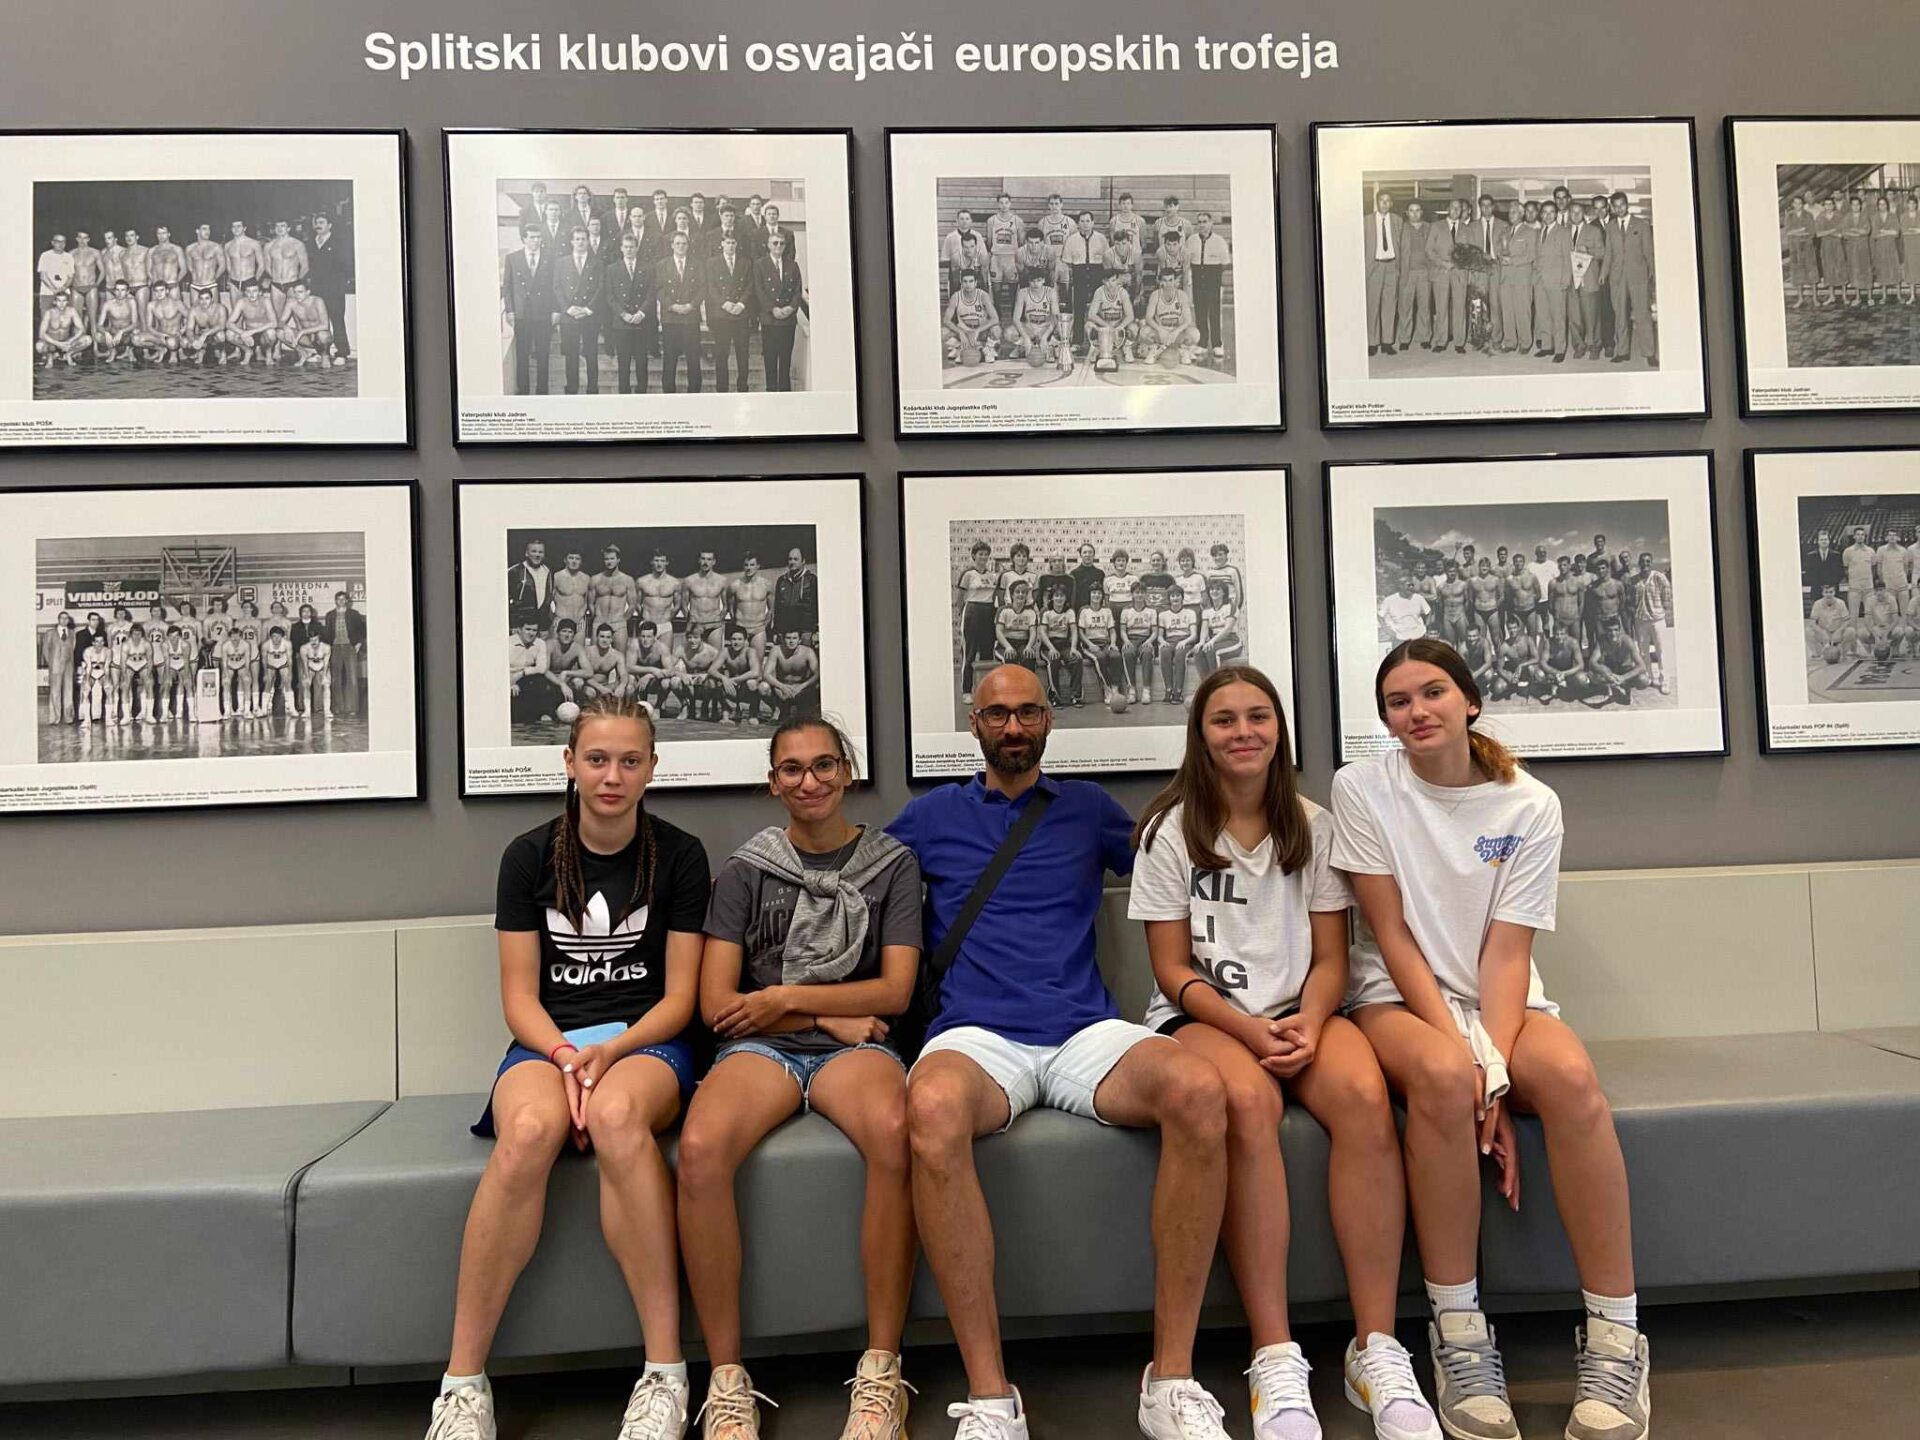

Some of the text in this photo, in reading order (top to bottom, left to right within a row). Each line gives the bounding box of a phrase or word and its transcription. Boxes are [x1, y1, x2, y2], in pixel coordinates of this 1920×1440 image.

[365, 32, 1338, 81] Splitski klubovi osvajači europskih trofeja
[272, 582, 331, 591] PRIVREDNA
[272, 589, 309, 598] BANKA
[67, 590, 159, 602] VINOPLOD
[1190, 867, 1248, 905] KIL
[550, 961, 648, 986] adidas
